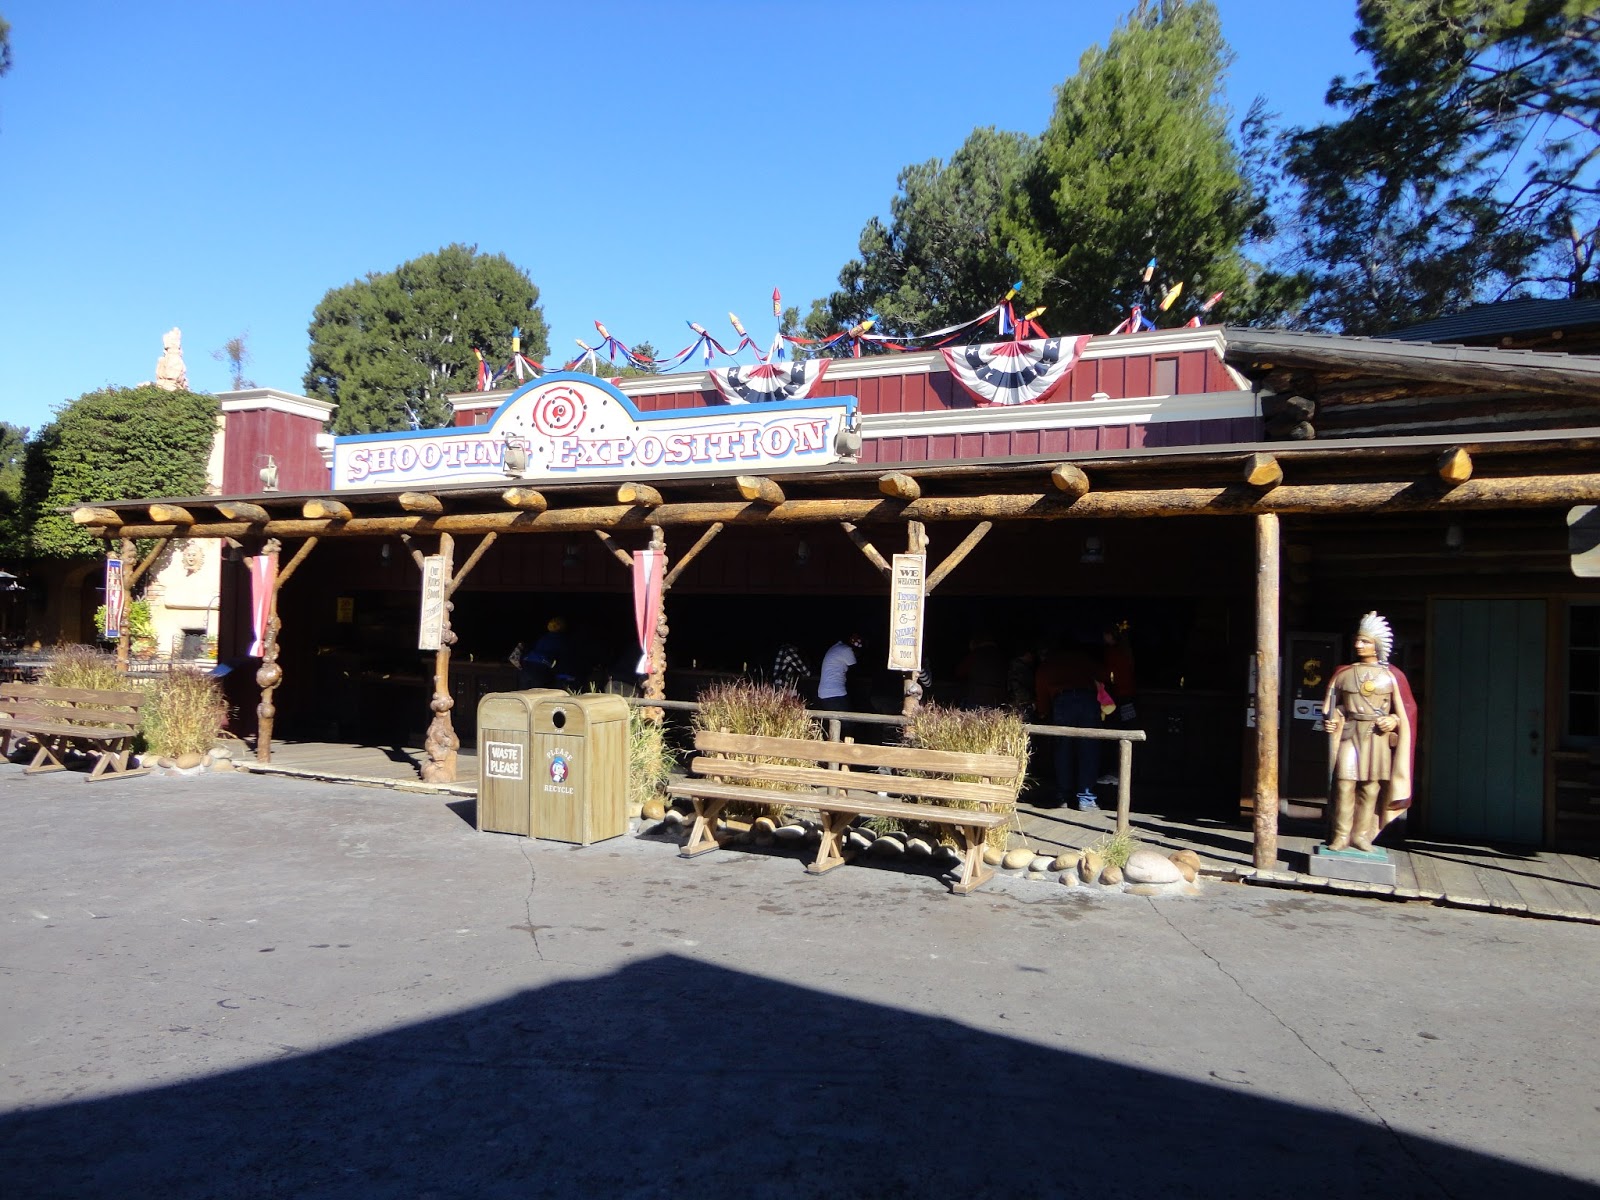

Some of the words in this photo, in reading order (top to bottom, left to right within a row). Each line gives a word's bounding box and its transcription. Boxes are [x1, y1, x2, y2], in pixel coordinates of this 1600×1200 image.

[547, 420, 829, 472] EXPOSITION
[899, 569, 919, 577] WE
[897, 578, 920, 586] WELCOME
[491, 747, 518, 760] WASTE
[546, 747, 573, 762] PLEASE
[490, 760, 519, 775] PLEASE
[544, 784, 574, 795] RECYCLE
